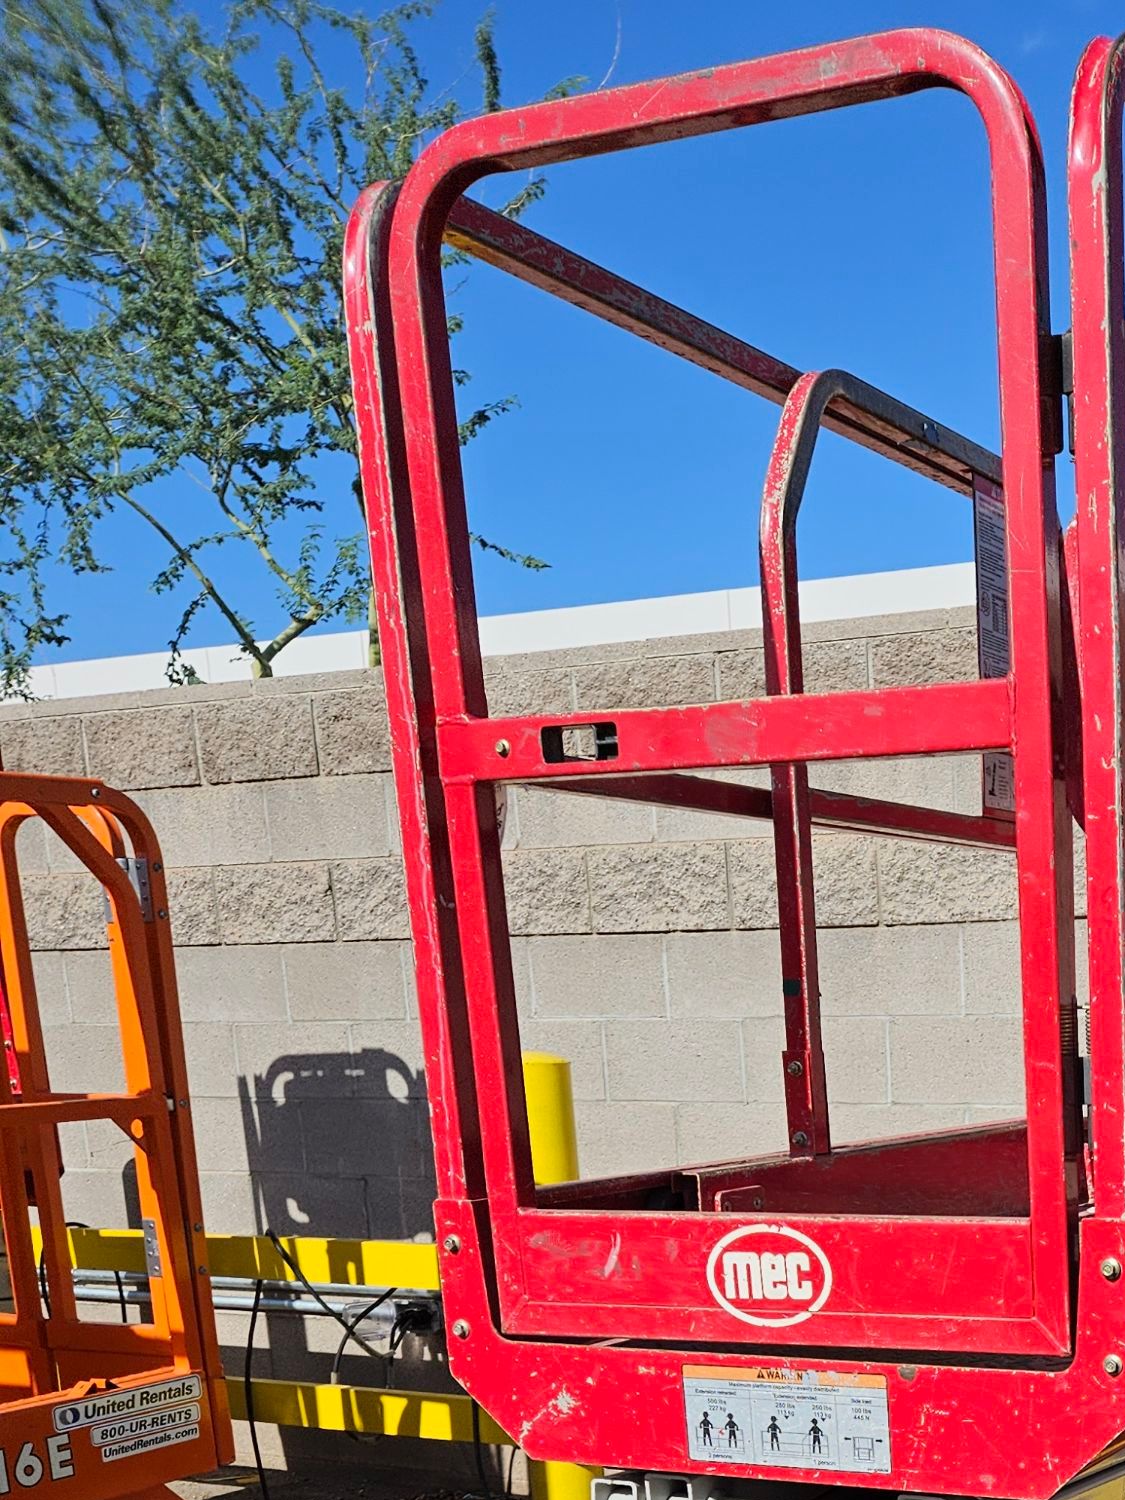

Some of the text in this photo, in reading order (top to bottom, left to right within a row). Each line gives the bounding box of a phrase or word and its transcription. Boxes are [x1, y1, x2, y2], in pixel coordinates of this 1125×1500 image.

[722, 1251, 813, 1300] mec
[84, 1382, 193, 1419] United Rentals
[100, 1408, 192, 1440] 800-UR-RENTS
[103, 1427, 198, 1458] UnitedRentals.com
